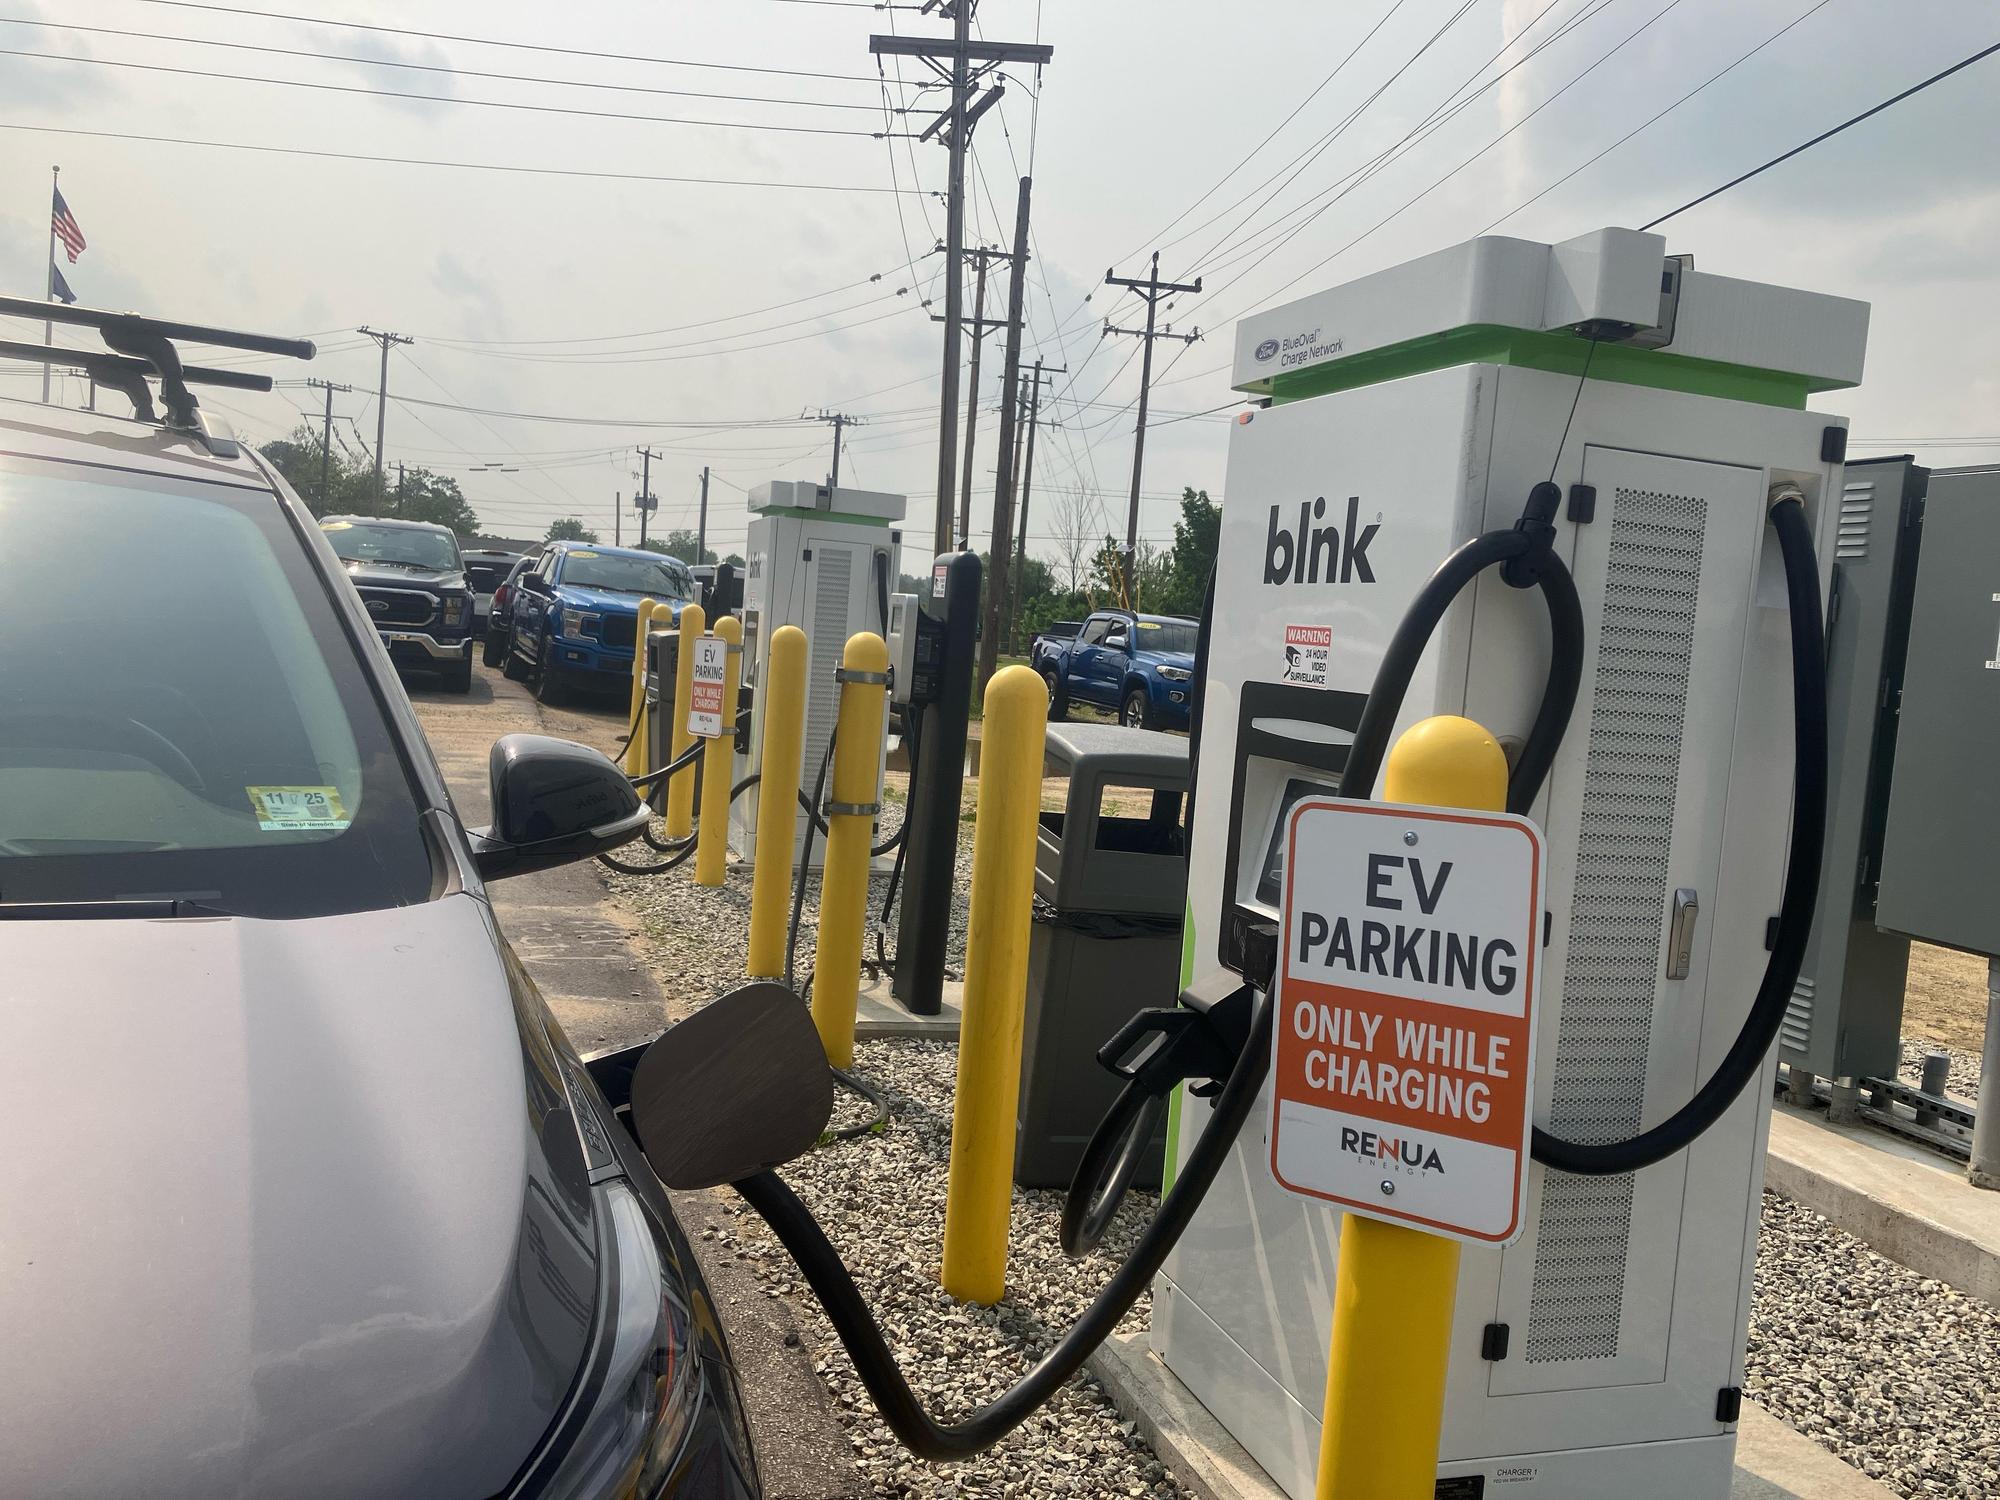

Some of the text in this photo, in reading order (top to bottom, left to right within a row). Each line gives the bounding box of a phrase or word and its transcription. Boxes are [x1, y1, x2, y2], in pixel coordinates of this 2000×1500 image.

[1281, 339, 1343, 367] Charge Network
[1263, 496, 1381, 586] blink
[1288, 629, 1330, 644] WARNING
[704, 649, 716, 663] EV
[1306, 649, 1327, 660] 24 HOUR
[695, 665, 722, 680] PARKING
[1312, 662, 1326, 672] VIDEO
[1290, 671, 1325, 685] SURVEILLANCE
[694, 686, 722, 699] ONLY WHILE
[695, 699, 719, 710] CHARGING
[266, 792, 325, 805] 11 25
[1365, 853, 1453, 915] EV
[1300, 911, 1517, 996] PARKING
[1293, 1000, 1511, 1079] ONLY WHILE
[1305, 1049, 1491, 1124] CHARGING
[1341, 1127, 1446, 1174] RENUA
[1358, 1156, 1428, 1178] ENERGY
[1497, 1469, 1532, 1477] CHARGER
